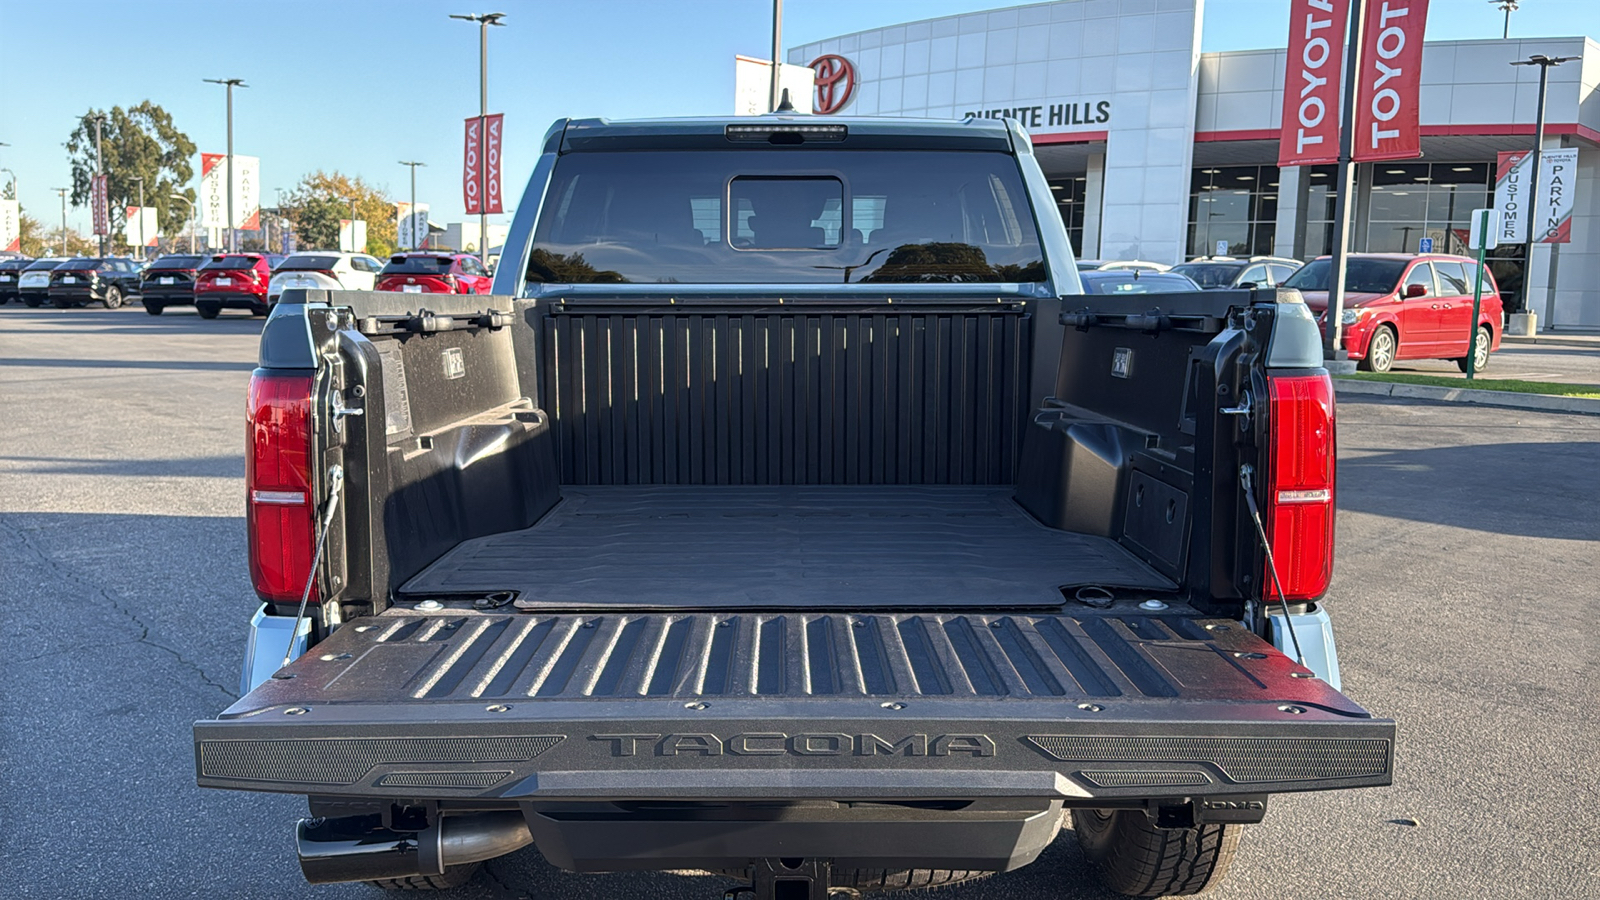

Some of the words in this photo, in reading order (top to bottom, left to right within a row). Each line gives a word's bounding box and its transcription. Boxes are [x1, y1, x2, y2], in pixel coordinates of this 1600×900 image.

[1371, 1, 1409, 149] TOYOT
[1049, 101, 1110, 127] HILLS
[466, 123, 478, 210] TOYOTA
[488, 120, 499, 209] TOYOTA
[1503, 166, 1520, 238] CUSTOMER
[1546, 165, 1564, 238] PARKING
[589, 732, 996, 757] TACOMA
[1204, 800, 1264, 811] OMA
